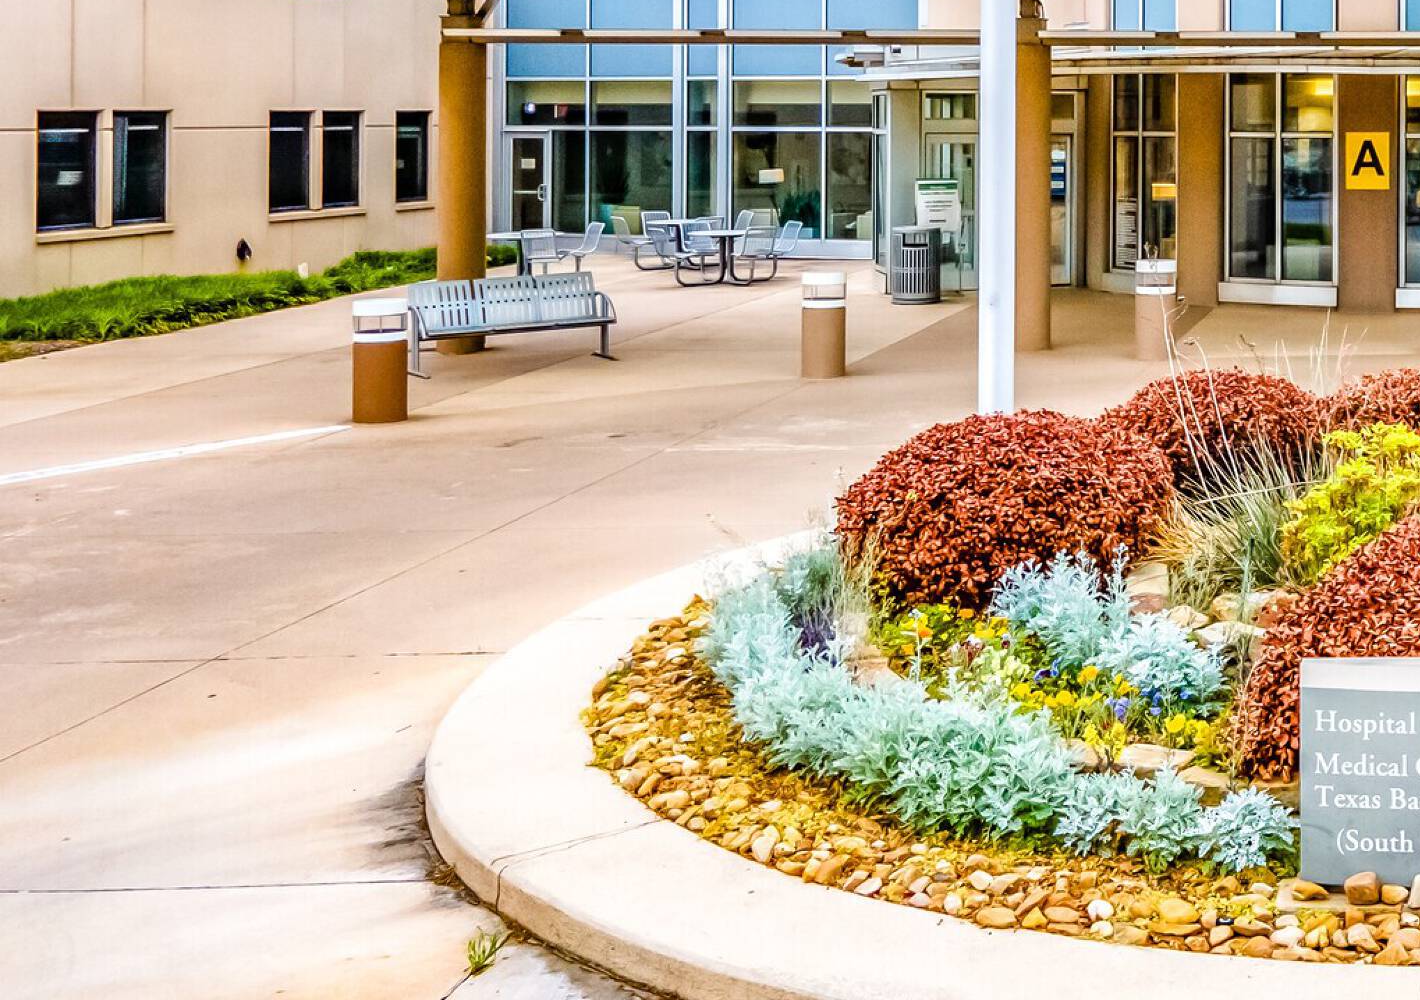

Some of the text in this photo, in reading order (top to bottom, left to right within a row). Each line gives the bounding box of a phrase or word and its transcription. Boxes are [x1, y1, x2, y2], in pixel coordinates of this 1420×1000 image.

[1351, 139, 1385, 177] A
[1314, 709, 1417, 740] Hospital
[1314, 752, 1408, 777] Medical
[1314, 785, 1381, 809] Texas
[1336, 828, 1414, 855] (South
